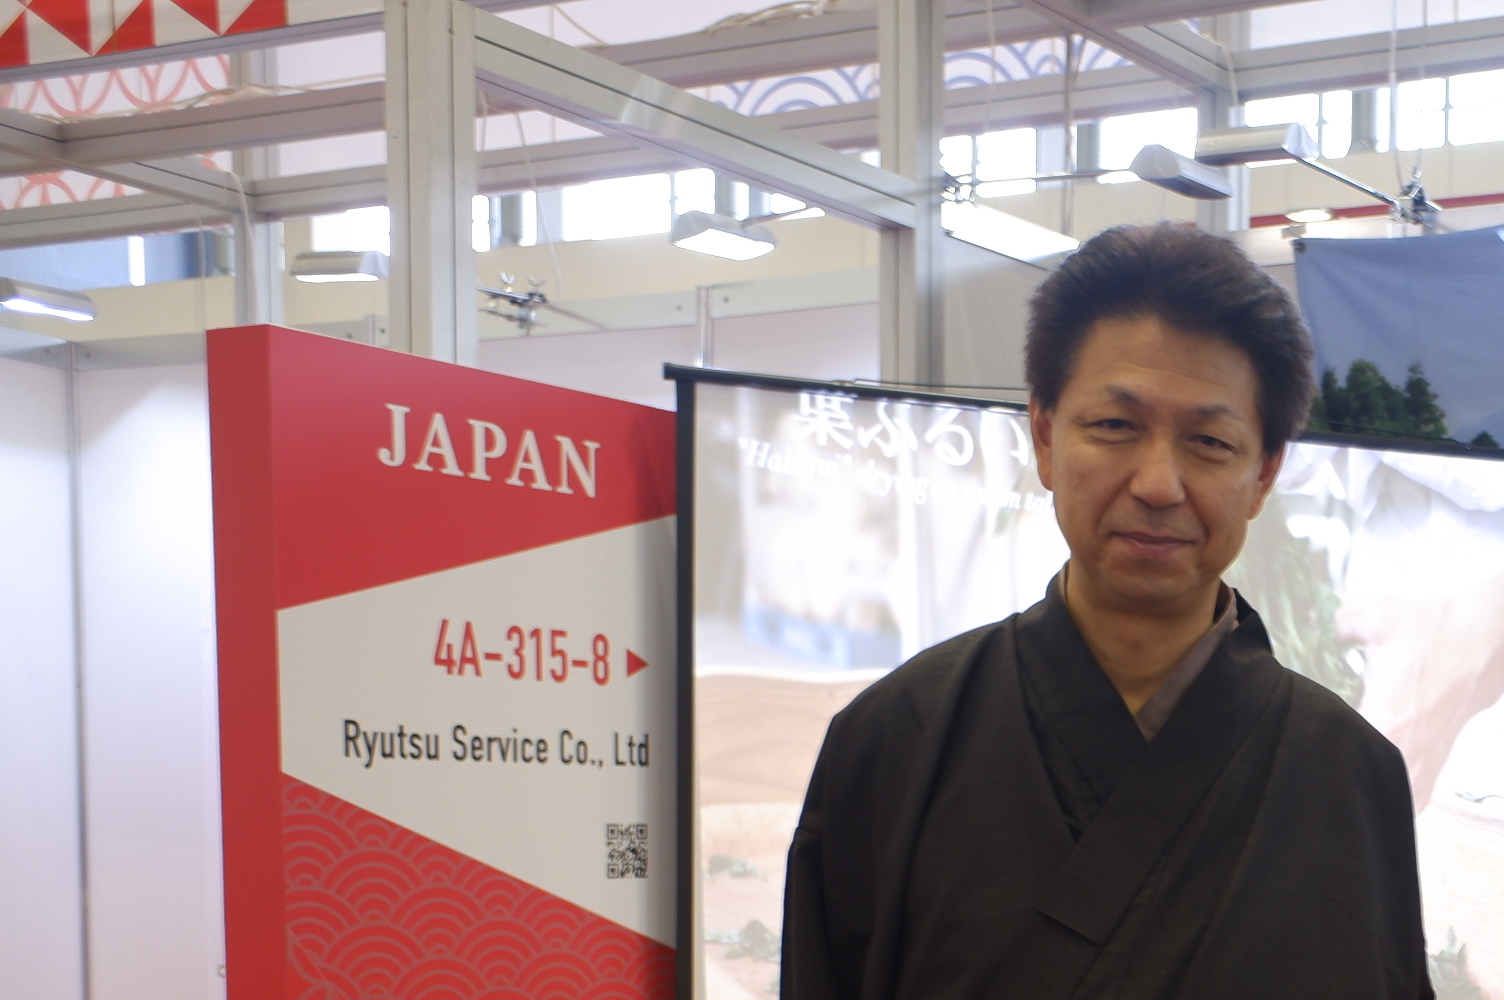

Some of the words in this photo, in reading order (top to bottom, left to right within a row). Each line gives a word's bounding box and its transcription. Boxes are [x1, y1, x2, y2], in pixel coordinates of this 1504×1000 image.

[377, 403, 601, 498] JAPAN
[434, 619, 611, 685] 4A-315-8
[343, 719, 440, 768] Ryutsu
[452, 725, 549, 763] Service
[559, 730, 604, 768] Co.,
[614, 732, 650, 768] Ltd
